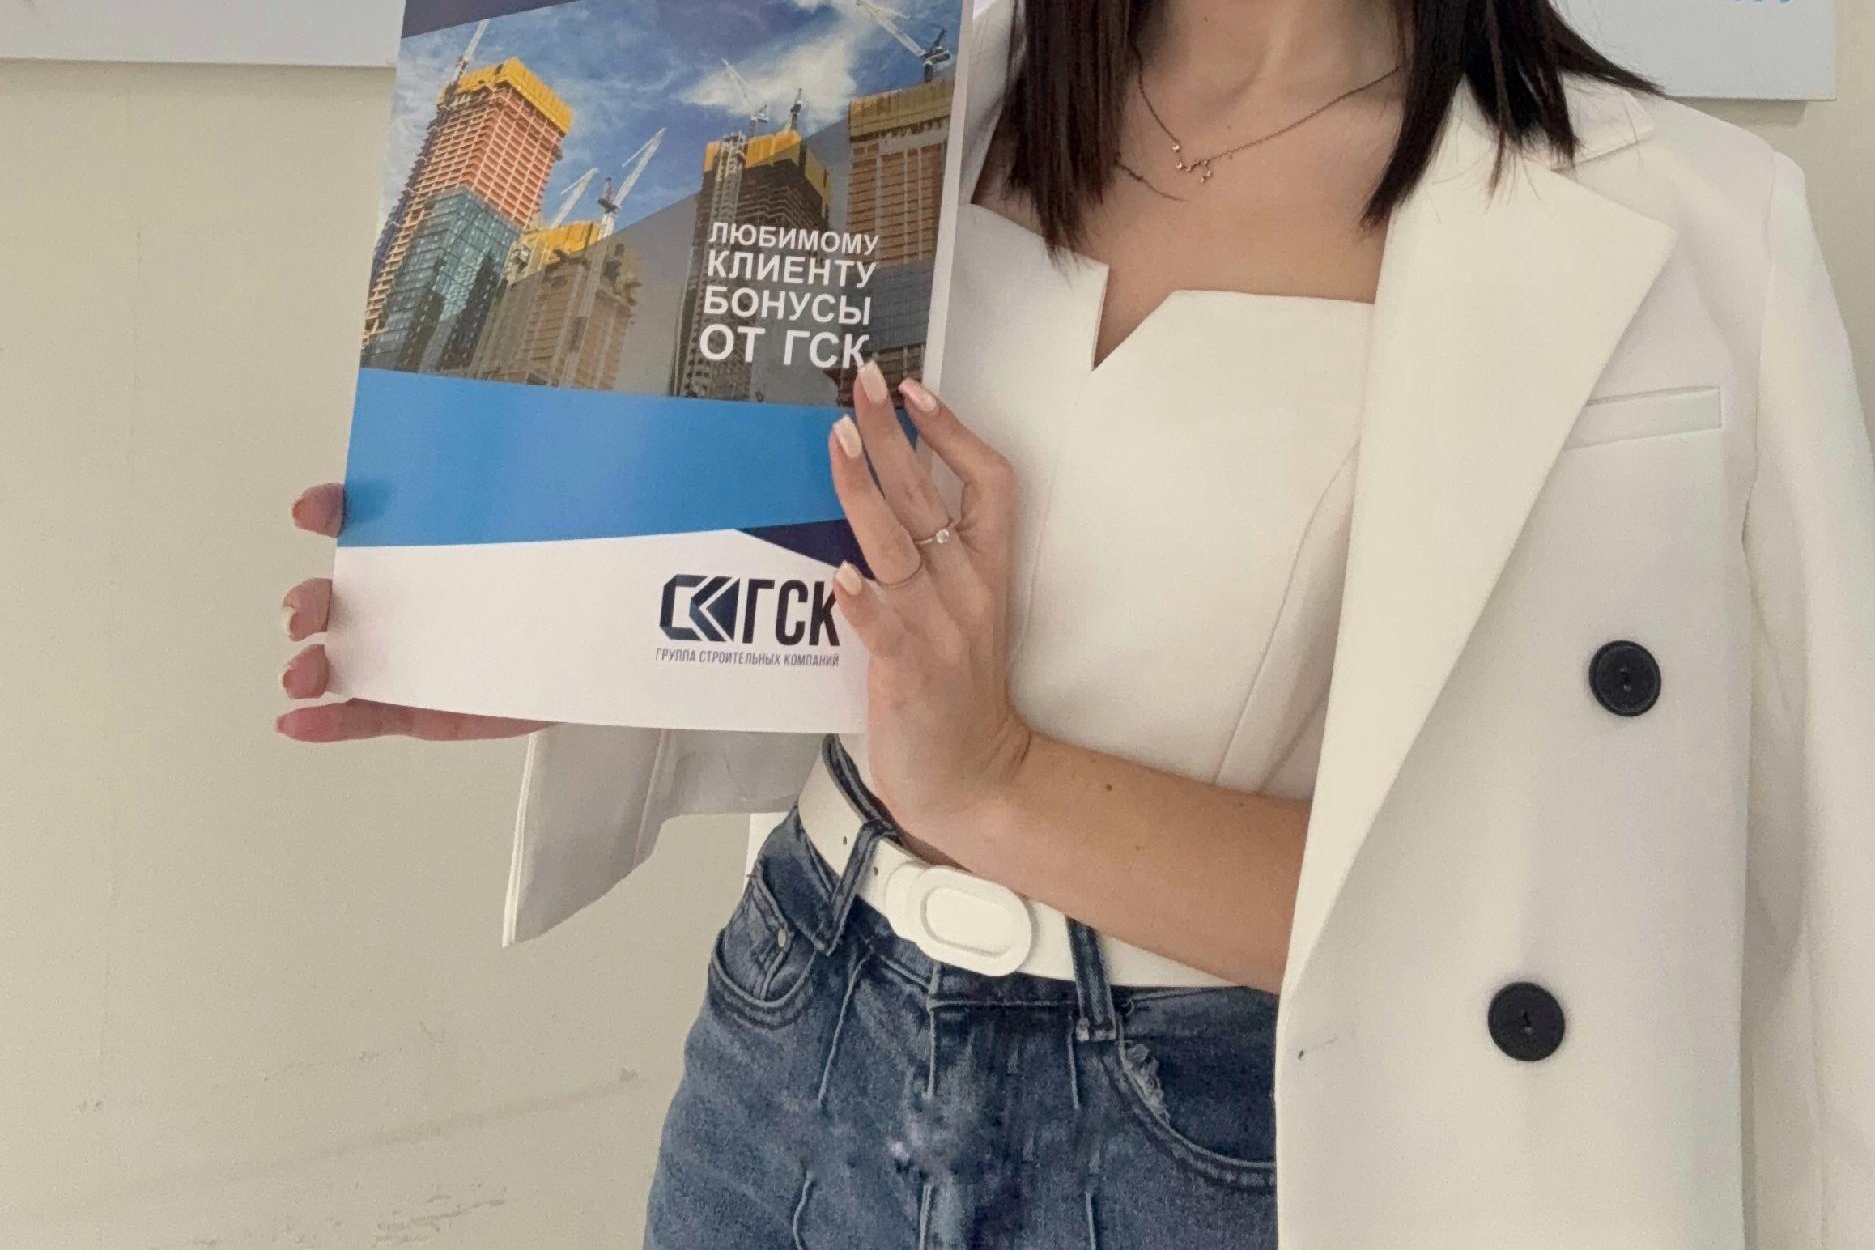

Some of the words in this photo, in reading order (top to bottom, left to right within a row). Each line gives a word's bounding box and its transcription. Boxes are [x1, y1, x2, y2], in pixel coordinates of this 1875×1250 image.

[708, 222, 879, 255] ЛЮБИМОМУ
[707, 249, 878, 288] КЛИЕНТУ
[703, 285, 871, 326] БОНУСЫ
[699, 324, 766, 364] ОТ
[783, 329, 869, 369] ГСК
[742, 578, 840, 647] ГСК
[656, 648, 696, 663] ГРУППА
[699, 650, 781, 666] СТРОИТЕЛЬНЫХ
[783, 652, 840, 668] КОМПАНИЙ
